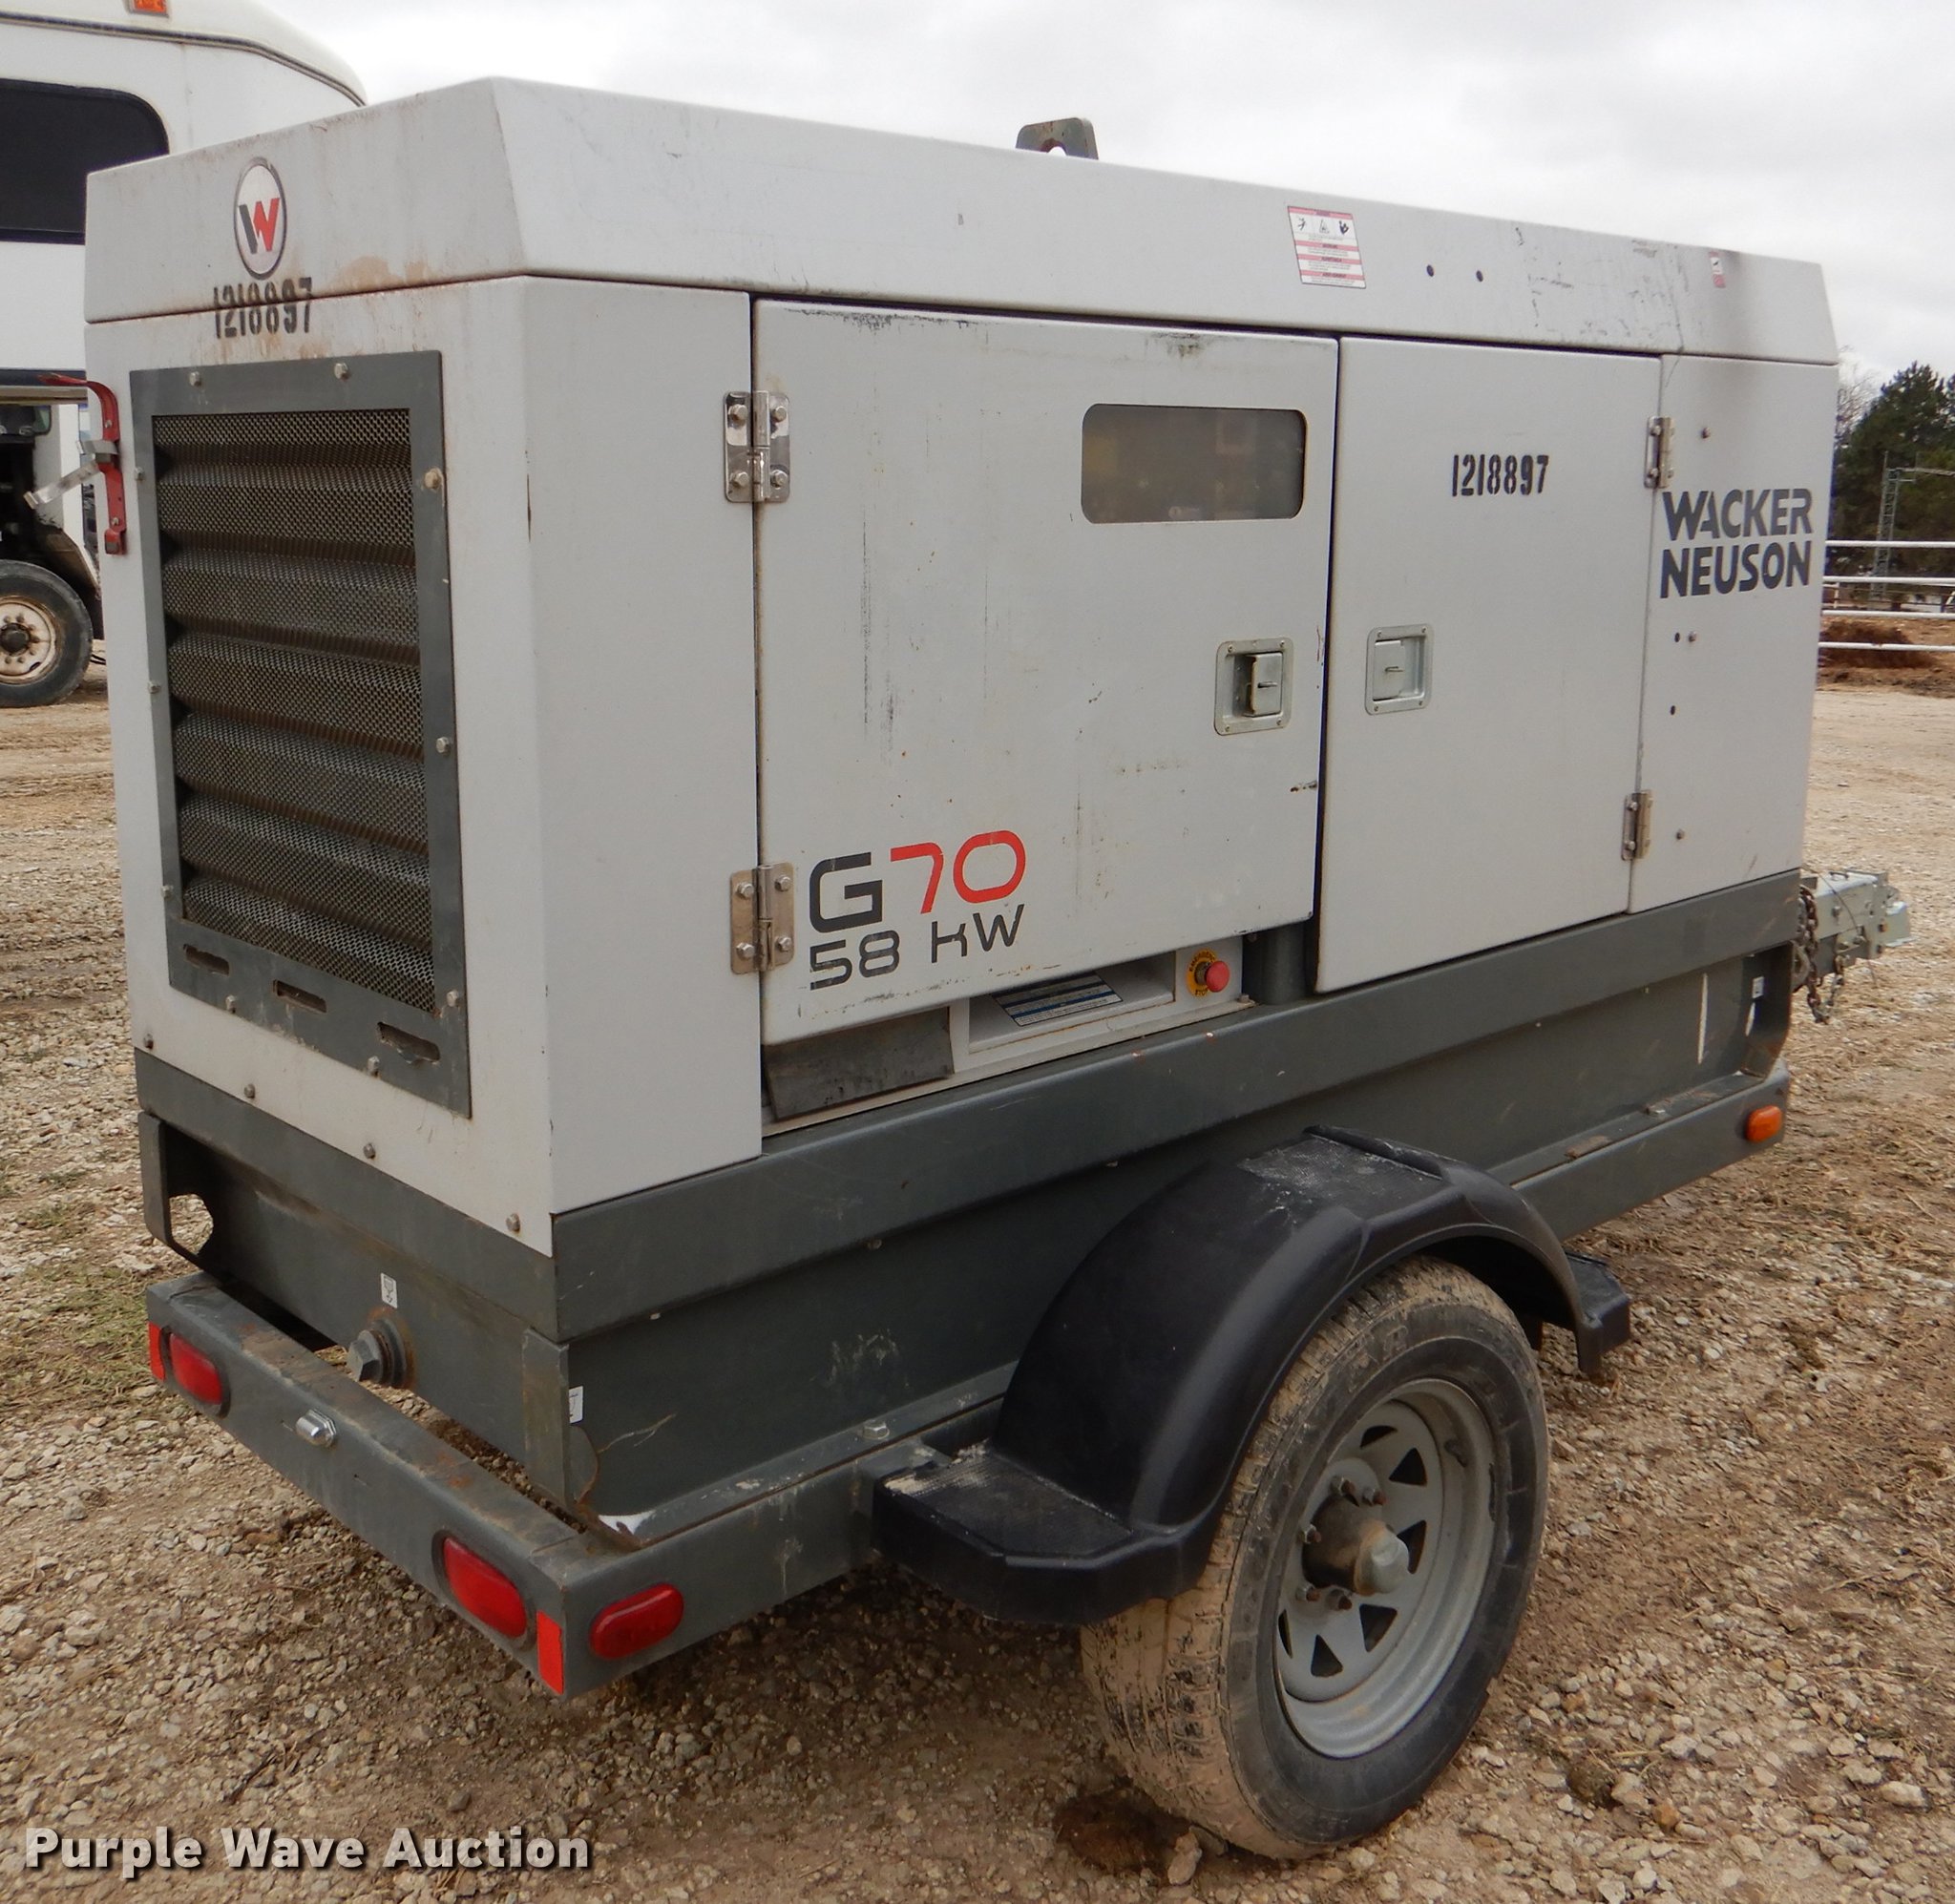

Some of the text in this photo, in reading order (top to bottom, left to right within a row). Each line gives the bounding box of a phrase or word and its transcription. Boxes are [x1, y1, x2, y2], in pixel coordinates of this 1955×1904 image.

[239, 198, 280, 255] W
[213, 277, 313, 340] 1218897
[1451, 453, 1550, 497] 1218897
[1662, 488, 1814, 541] WACKER
[1659, 540, 1813, 599] NEUSON
[809, 829, 1027, 933] G70
[809, 930, 900, 991] 58
